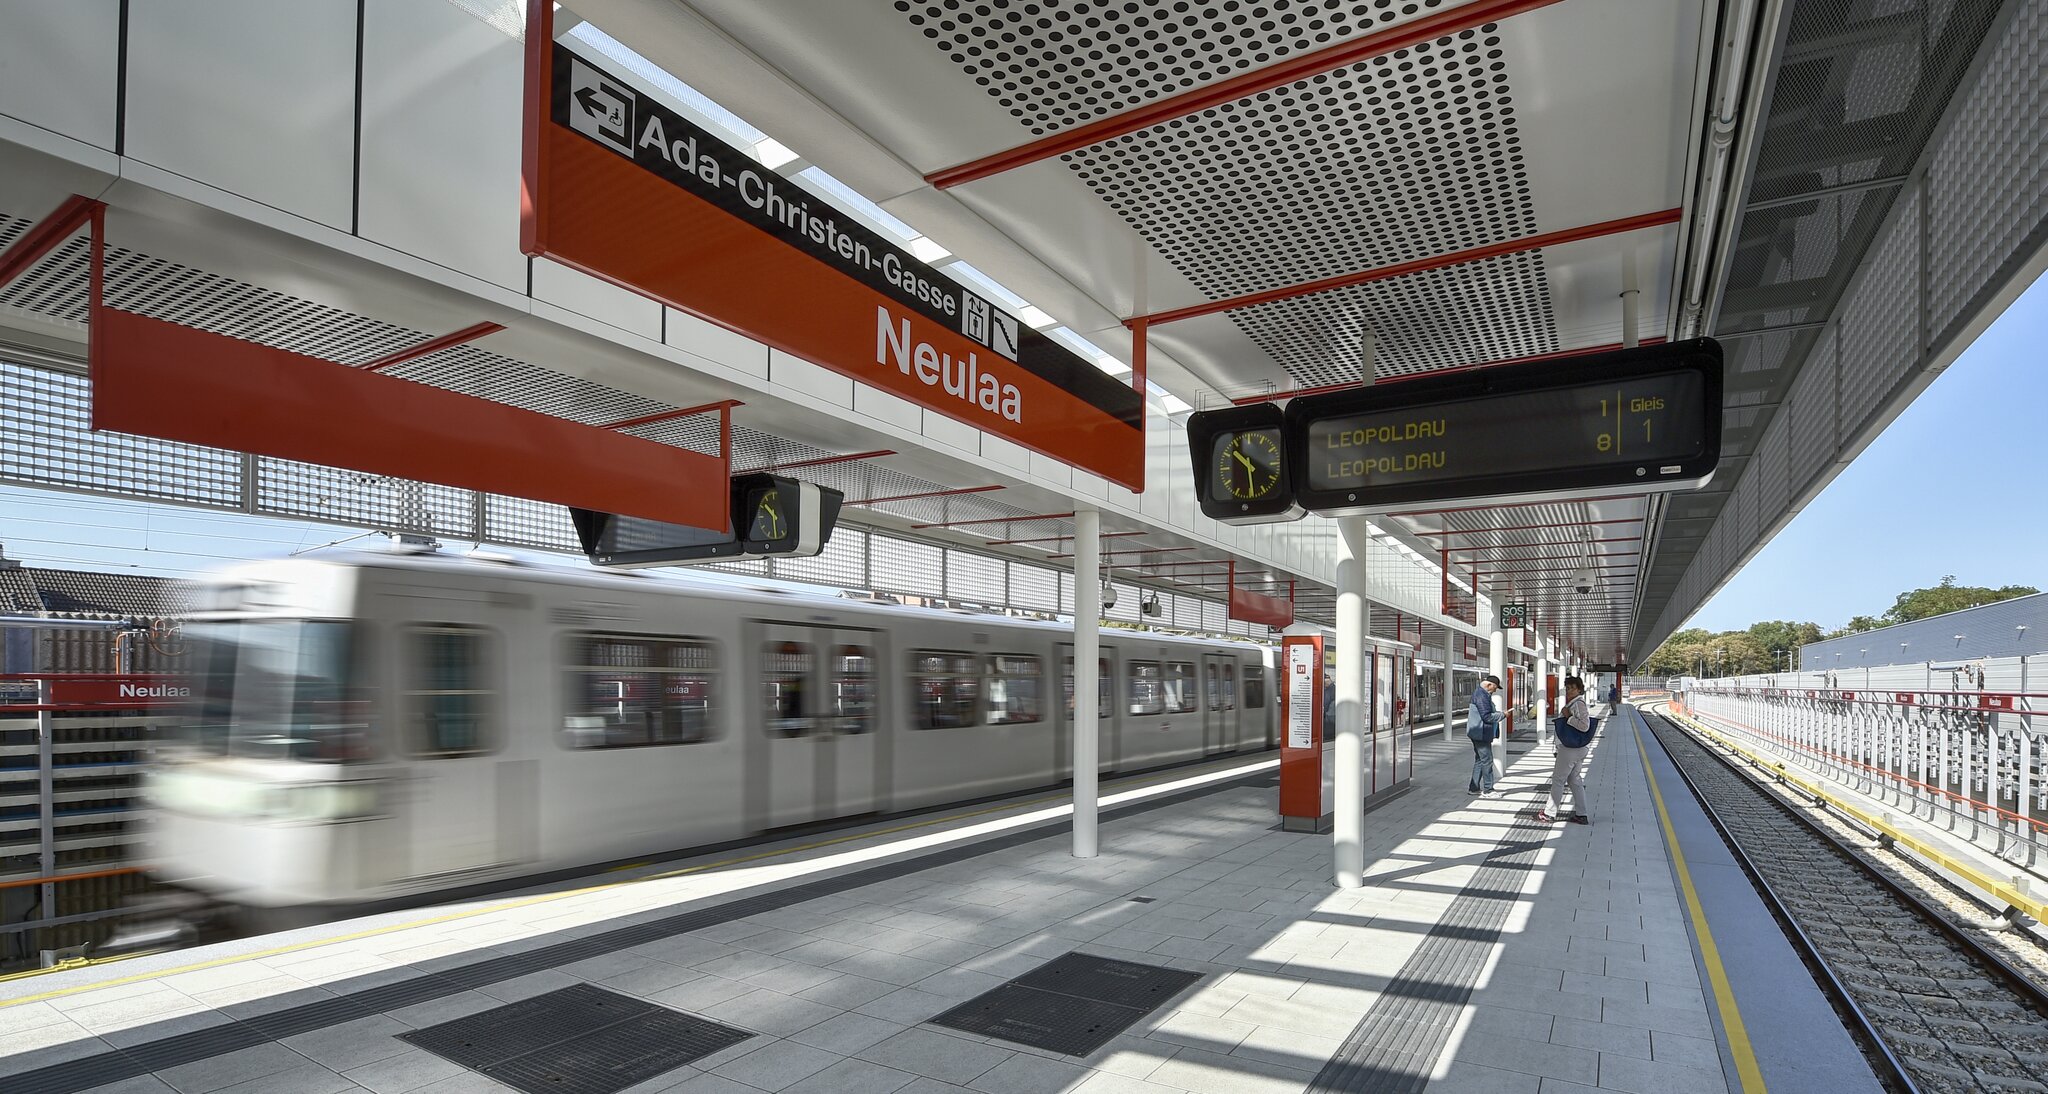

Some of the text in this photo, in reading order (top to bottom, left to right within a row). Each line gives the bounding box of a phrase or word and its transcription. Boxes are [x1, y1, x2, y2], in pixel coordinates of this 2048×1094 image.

[638, 114, 956, 317] Ada-Christen-Gasse
[876, 305, 1022, 424] Neulaa
[1630, 396, 1665, 413] Gleis
[1328, 399, 1607, 449] LEOPOLDAU 1
[1643, 418, 1651, 443] 1
[1328, 433, 1611, 478] LEOPOLDAU 8
[1502, 606, 1524, 616] SOS
[120, 684, 190, 697] Neulaa
[665, 685, 689, 694] eulaa
